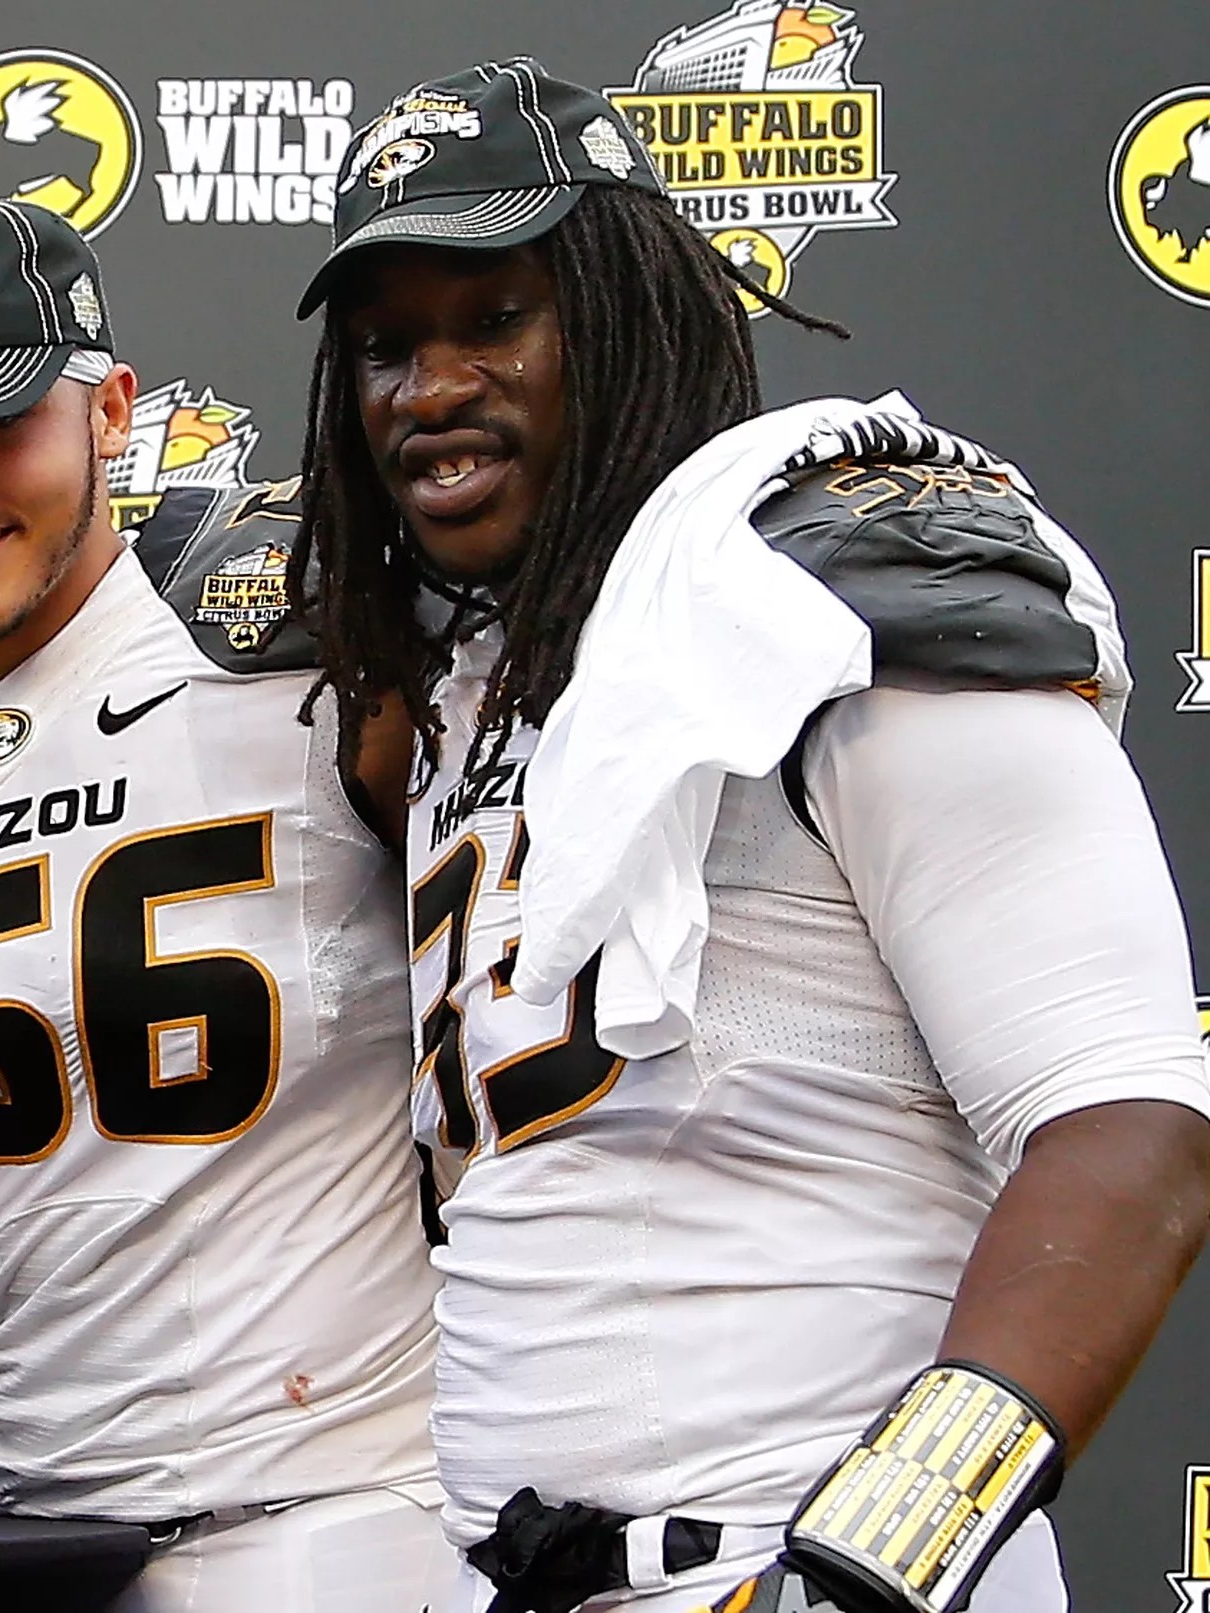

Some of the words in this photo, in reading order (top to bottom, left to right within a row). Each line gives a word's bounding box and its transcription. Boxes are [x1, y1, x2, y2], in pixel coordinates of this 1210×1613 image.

[156, 79, 353, 116] BUFFALO
[624, 100, 862, 145] BUFFALO
[158, 116, 352, 174] WILD
[663, 151, 726, 183] ILD
[735, 146, 863, 179] WINGS
[155, 174, 335, 224] WINGS
[764, 189, 863, 219] BOWL
[206, 594, 243, 607] WILD
[248, 591, 284, 605] WING
[207, 577, 284, 594] BUFFAL
